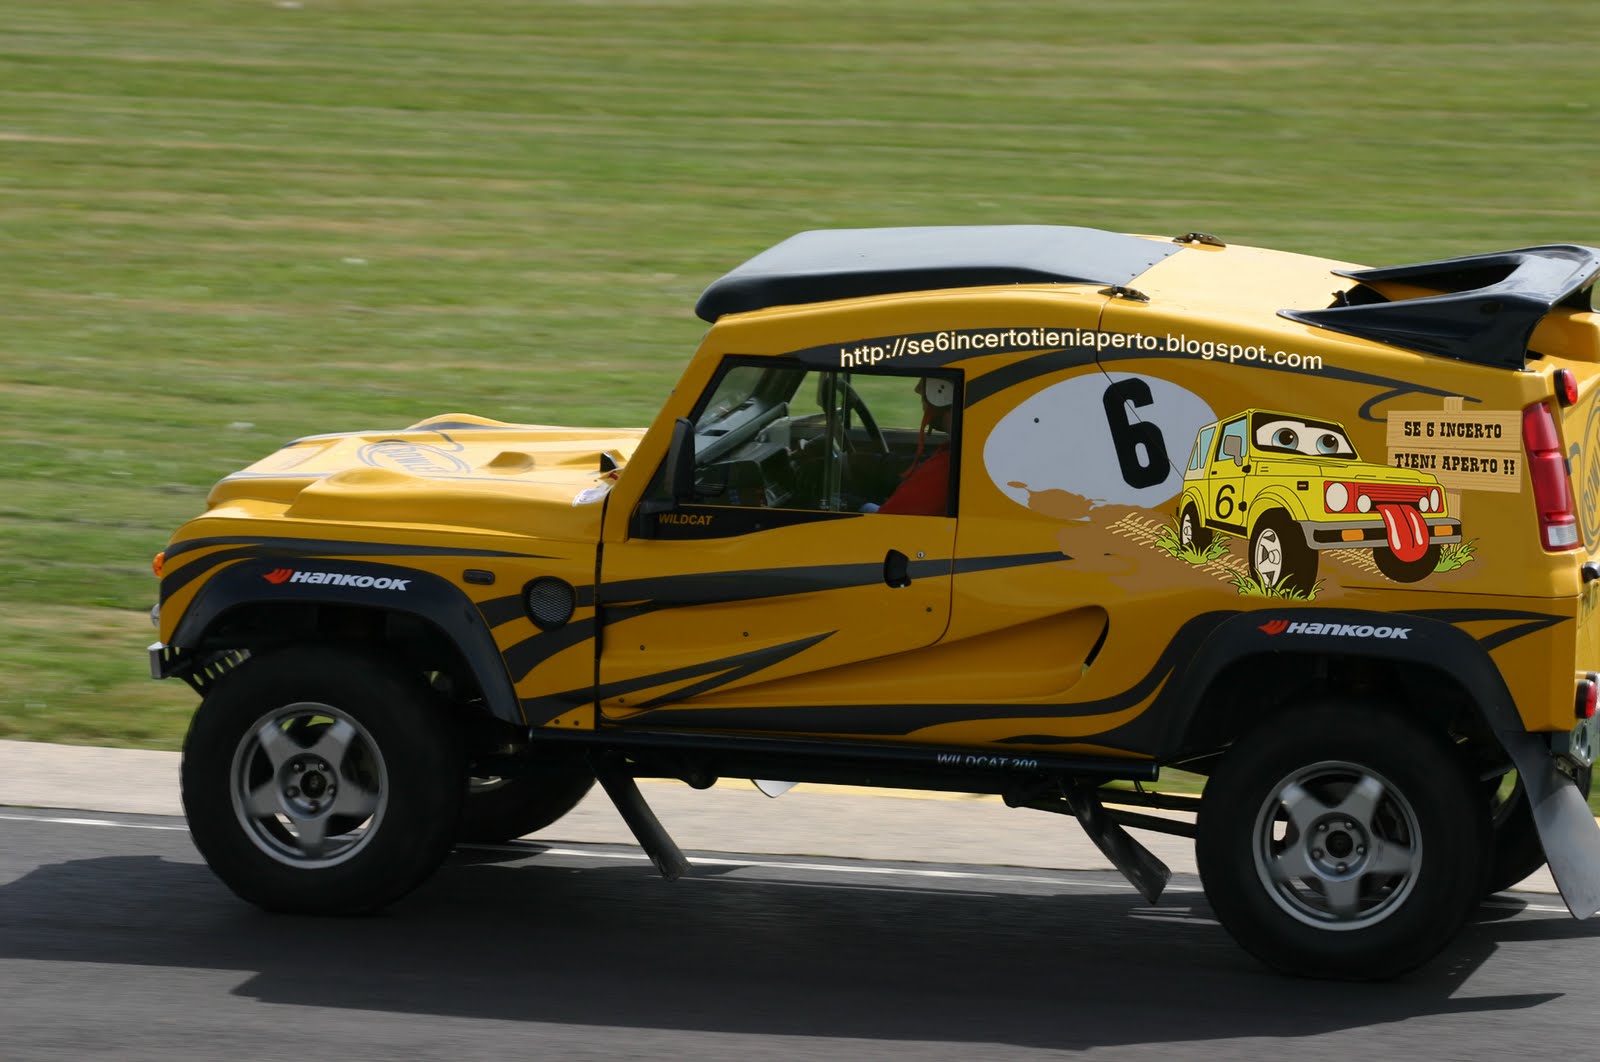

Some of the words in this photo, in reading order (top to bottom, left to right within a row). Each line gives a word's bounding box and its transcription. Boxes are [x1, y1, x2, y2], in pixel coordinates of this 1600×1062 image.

[840, 327, 1323, 369] http://se6incertotieniaperto.blogspot.com
[1102, 377, 1170, 489] 6
[1404, 421, 1421, 437] SE
[1426, 422, 1435, 437] 6
[1440, 422, 1502, 438] INCERTO
[1394, 453, 1436, 469] TIENI
[1442, 456, 1498, 473] APERTO
[1503, 459, 1515, 475] !!
[1215, 484, 1236, 520] 6
[659, 513, 713, 526] WILDCAT
